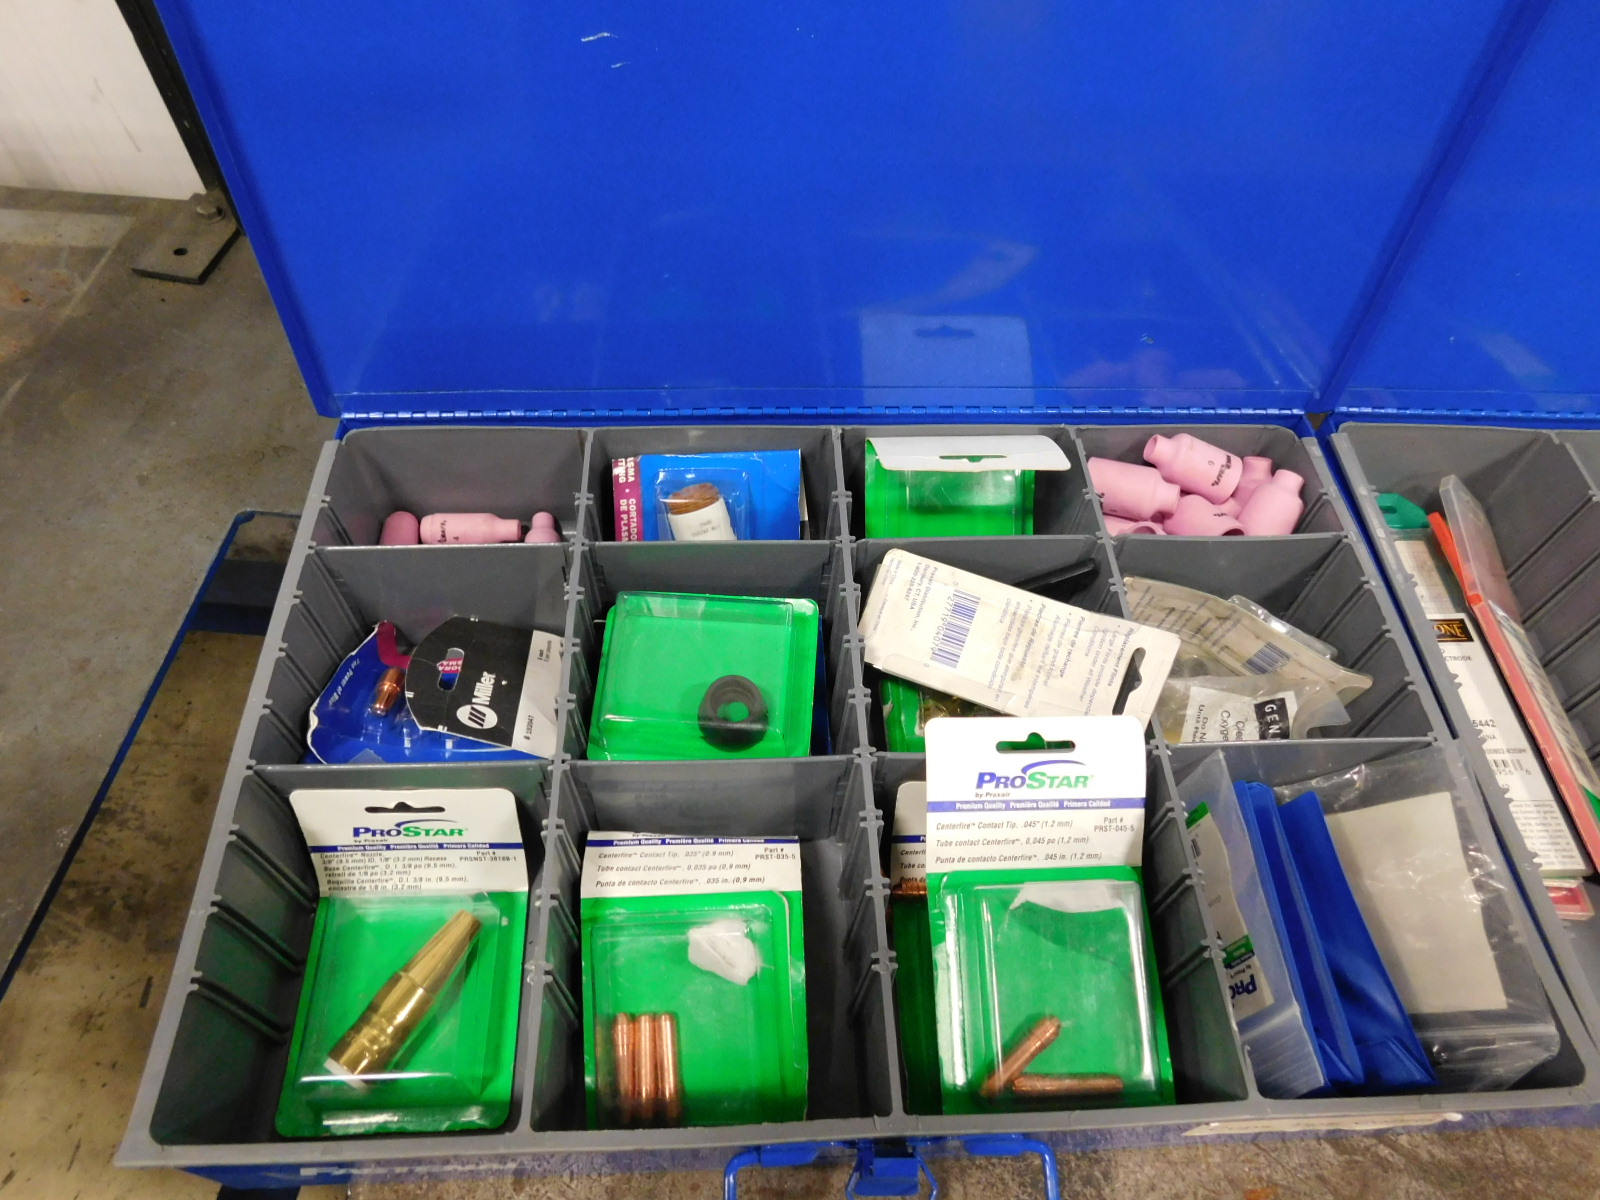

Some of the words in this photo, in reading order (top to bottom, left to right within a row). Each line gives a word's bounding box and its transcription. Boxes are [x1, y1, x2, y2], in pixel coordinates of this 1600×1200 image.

[472, 671, 496, 705] Miller
[935, 856, 955, 864] Punta
[967, 855, 996, 863] contacto
